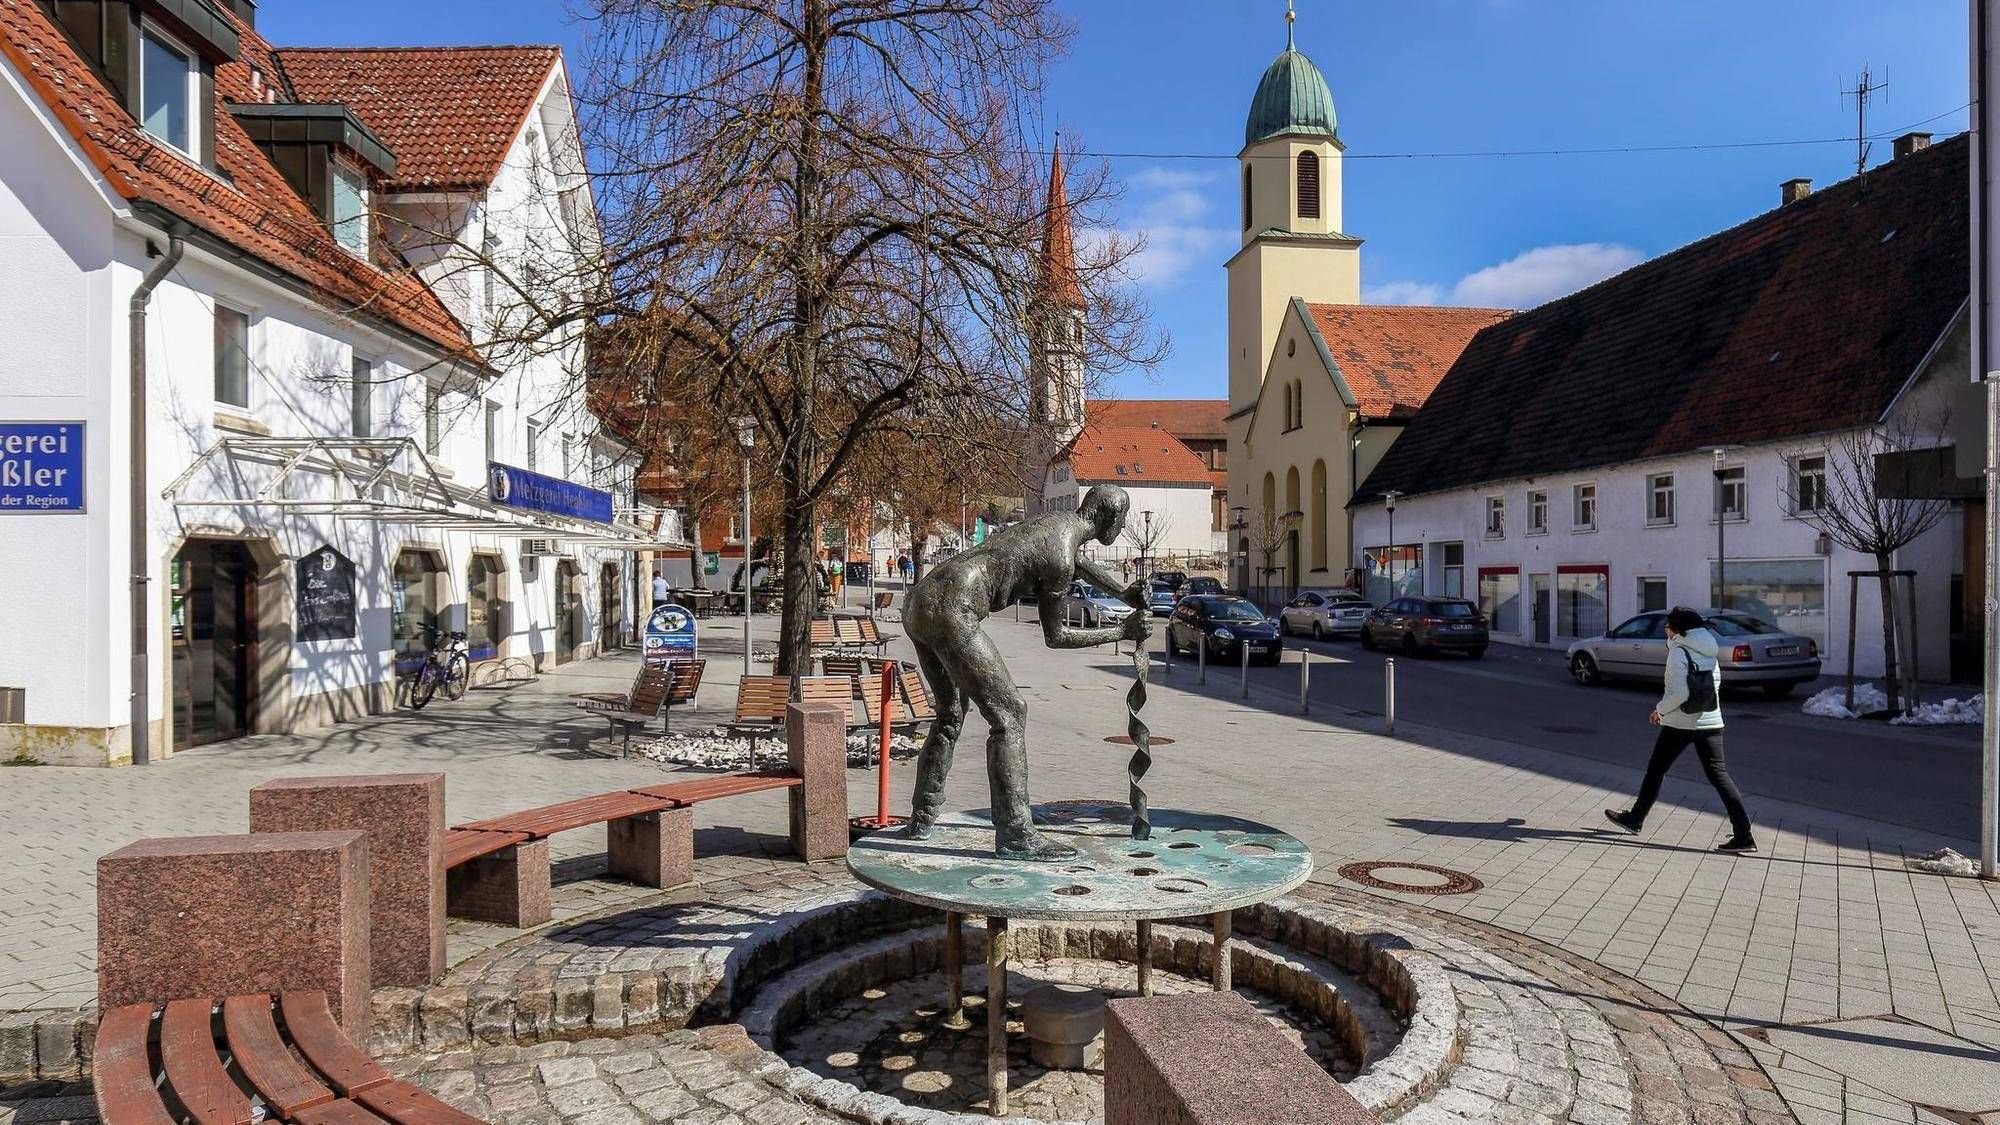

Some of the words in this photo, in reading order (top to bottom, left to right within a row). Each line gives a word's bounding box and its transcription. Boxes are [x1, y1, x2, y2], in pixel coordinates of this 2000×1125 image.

[0, 427, 67, 460] erei
[1, 494, 22, 506] der
[26, 494, 68, 509] Region
